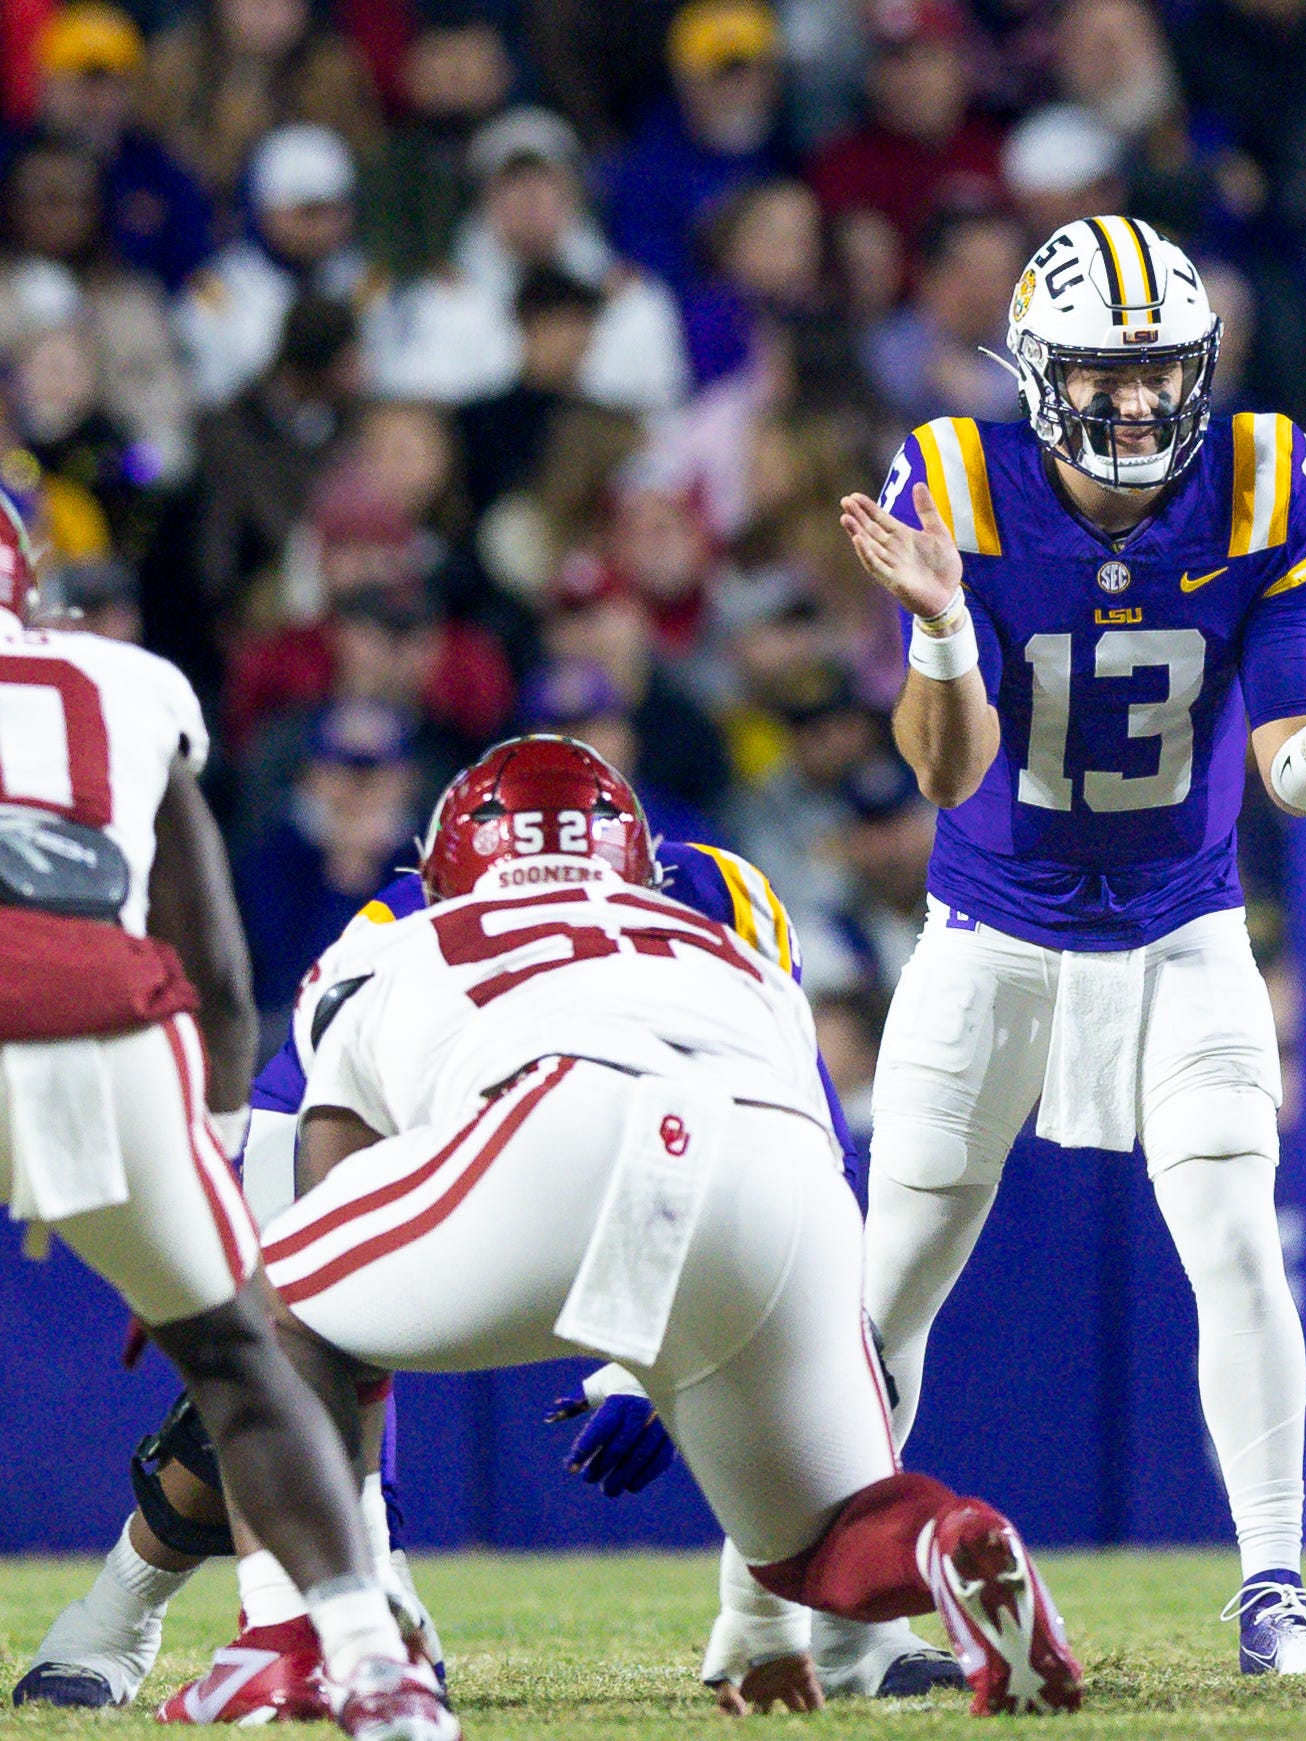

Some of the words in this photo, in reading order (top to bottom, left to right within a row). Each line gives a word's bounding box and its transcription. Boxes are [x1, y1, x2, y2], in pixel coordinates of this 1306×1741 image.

[1122, 329, 1160, 345] LSU
[1099, 563, 1129, 592] SEC
[1094, 607, 1143, 625] LSU
[1018, 629, 1206, 812] 13
[513, 809, 589, 854] 52
